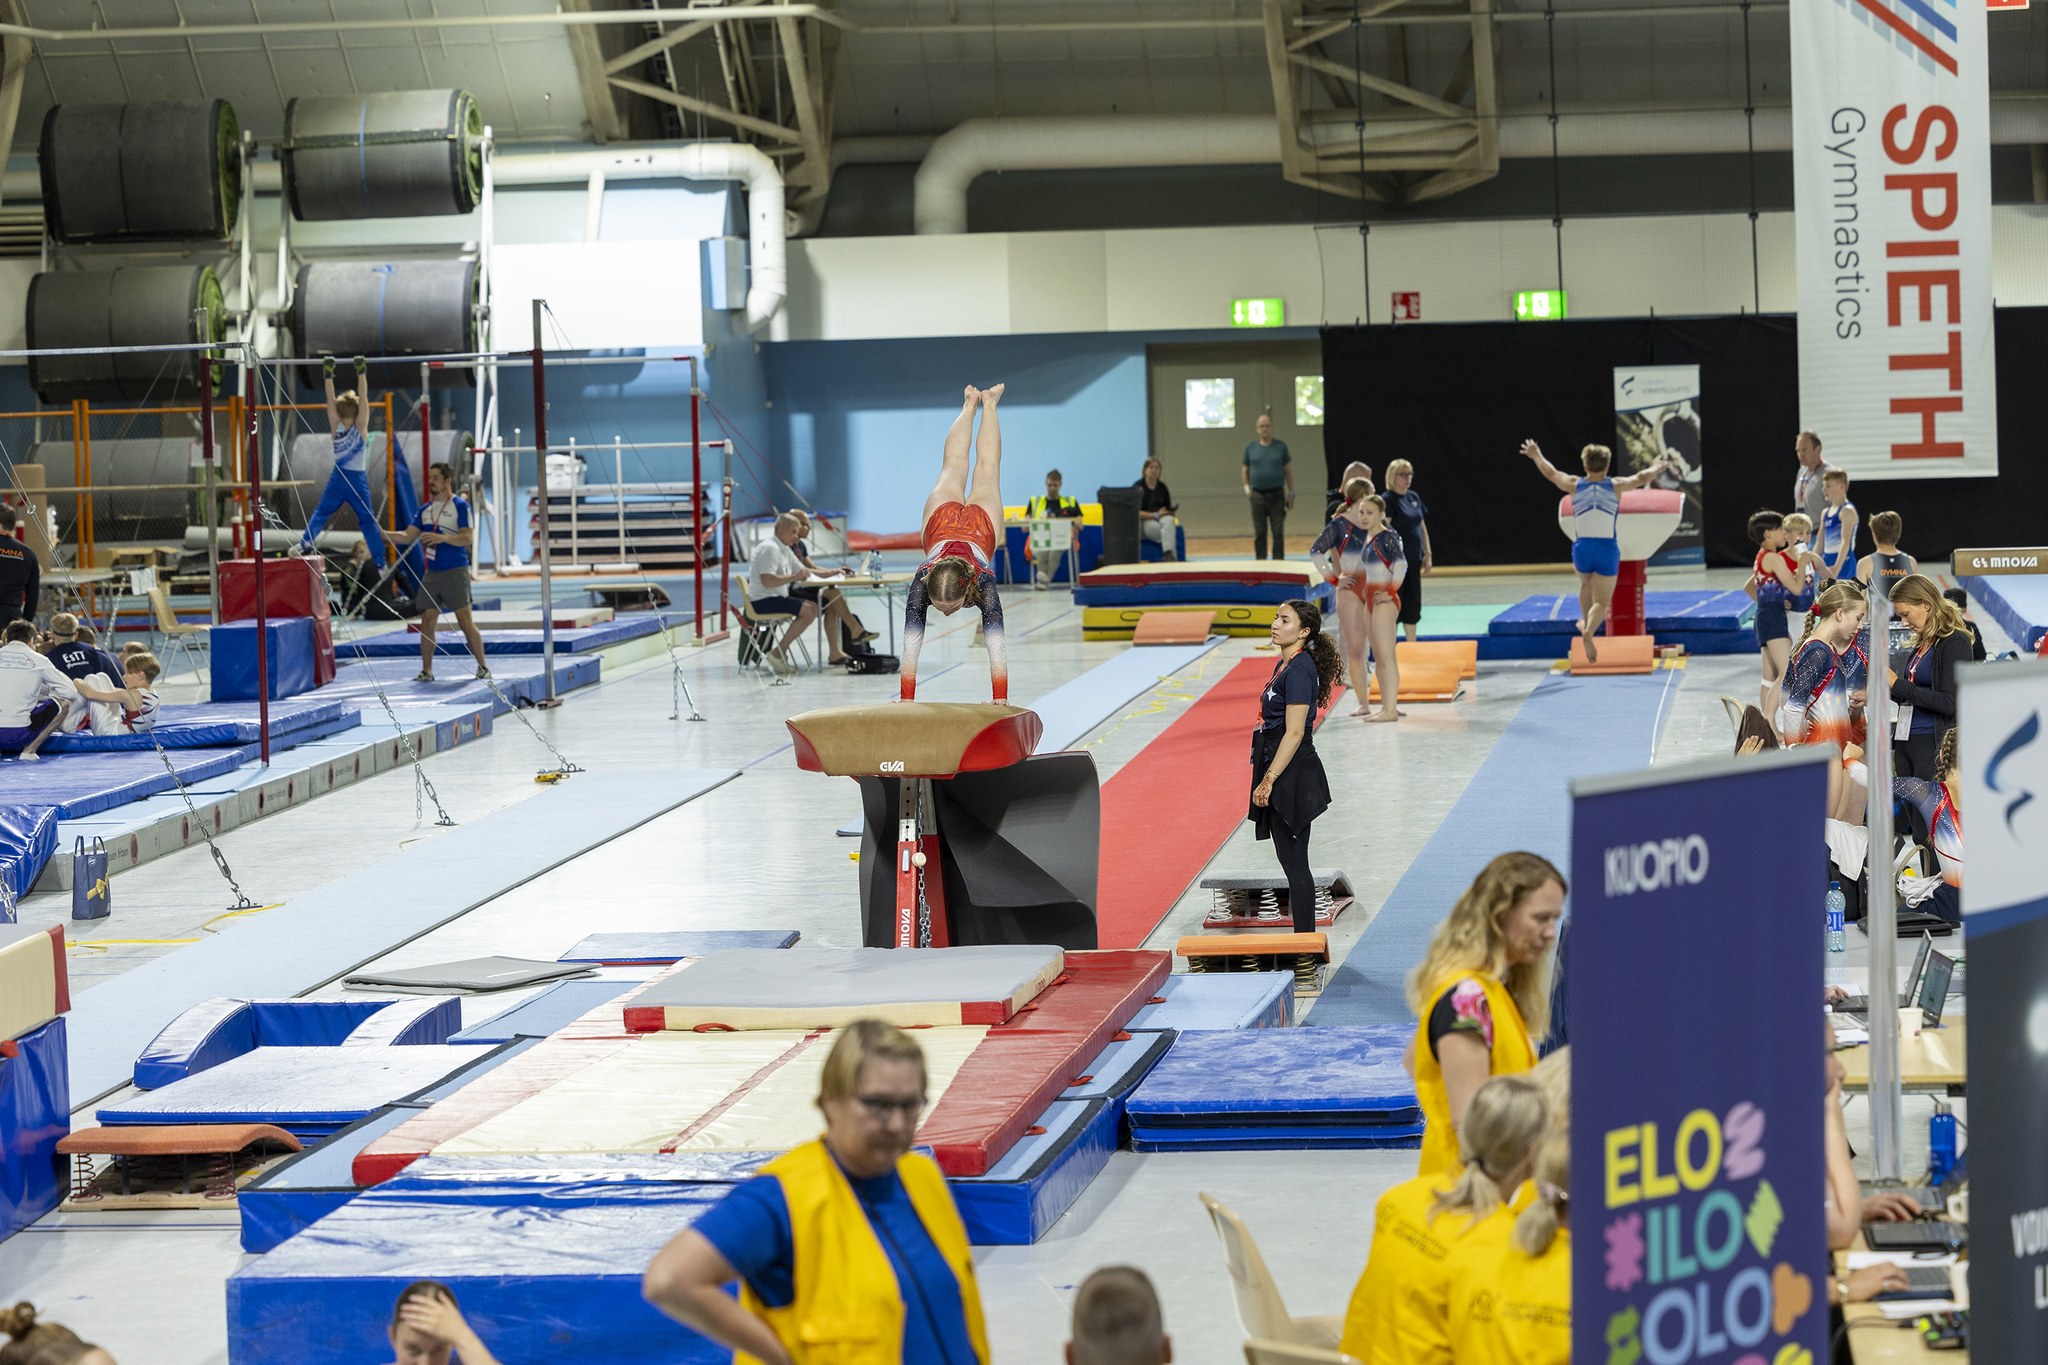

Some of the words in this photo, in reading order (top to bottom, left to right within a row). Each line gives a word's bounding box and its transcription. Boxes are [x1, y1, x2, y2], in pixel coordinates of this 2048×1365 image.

[1823, 106, 1870, 340] Gymnastics
[1881, 102, 1965, 461] SPIETH
[1604, 833, 1710, 897] KUOPIO
[1604, 1108, 1723, 1209] ELO
[1646, 1189, 1743, 1285] ILO
[1642, 1266, 1772, 1365] OLO
